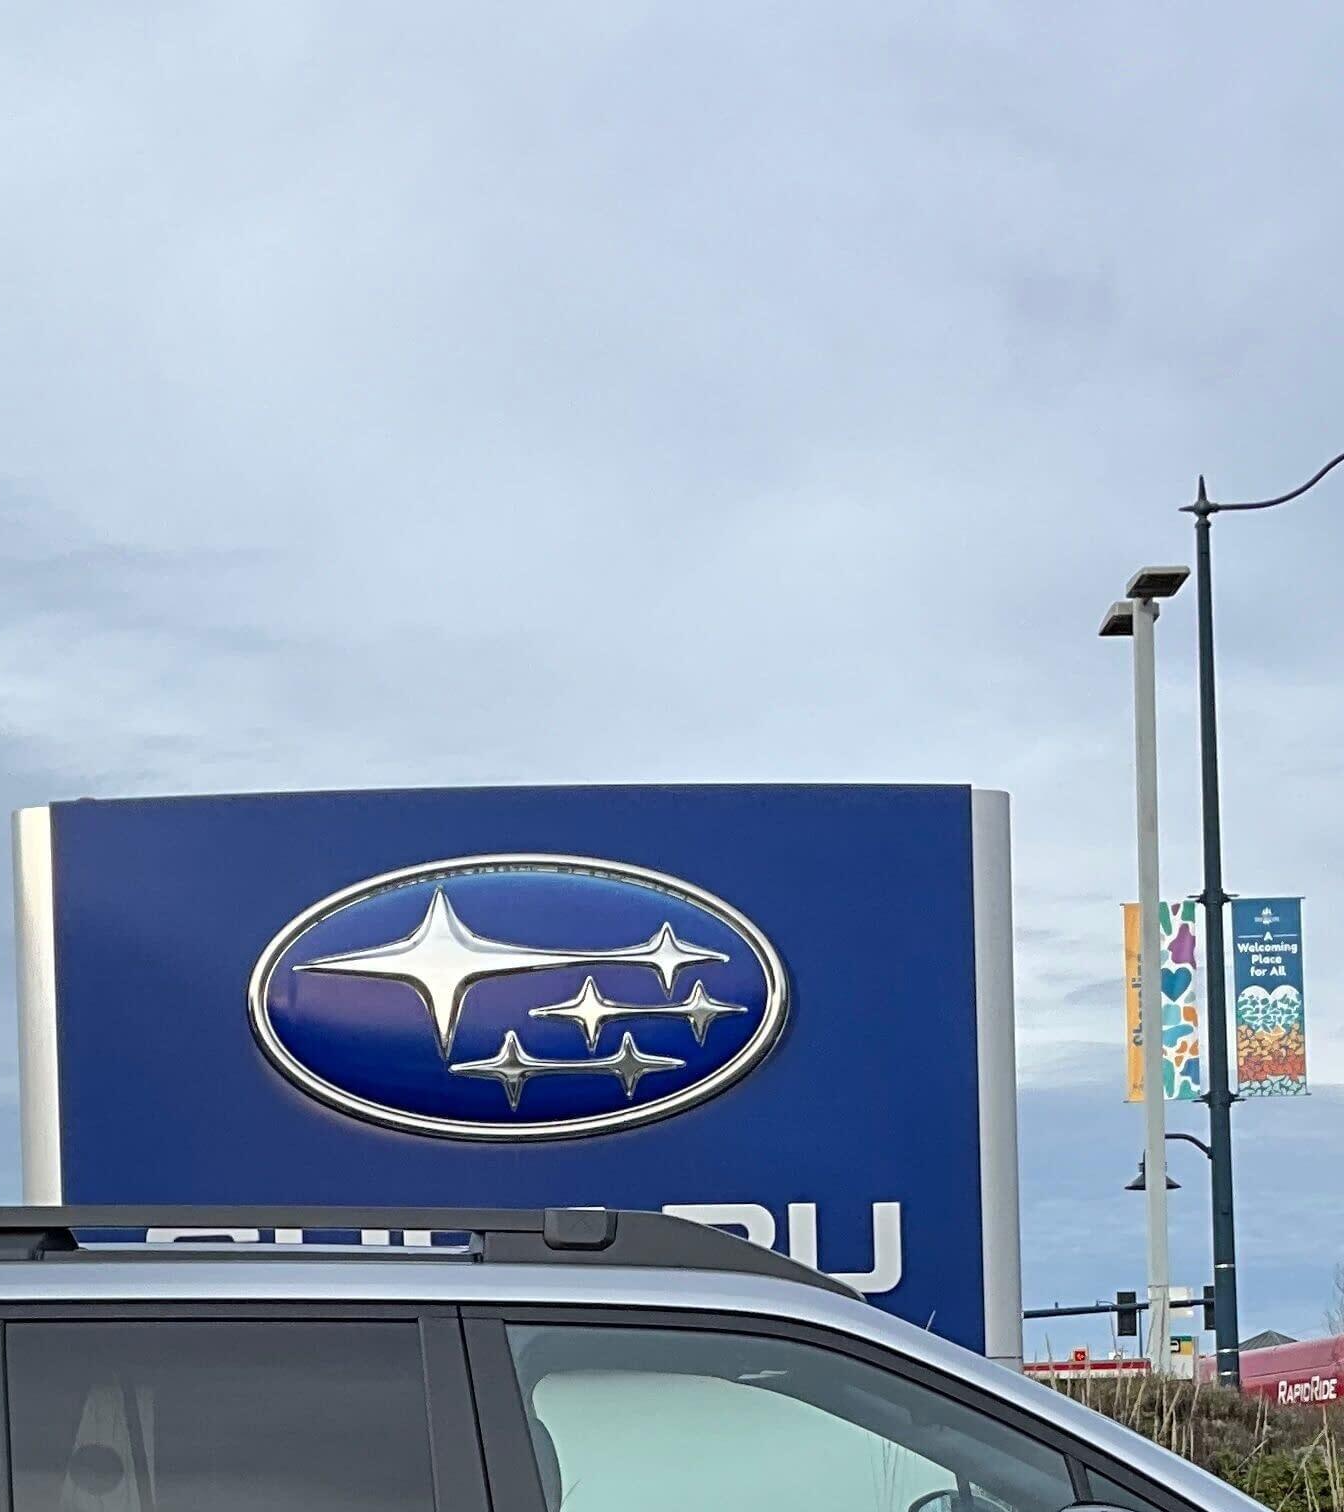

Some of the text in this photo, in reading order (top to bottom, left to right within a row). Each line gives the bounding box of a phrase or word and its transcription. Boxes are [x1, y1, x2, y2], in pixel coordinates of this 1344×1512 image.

[1263, 931, 1274, 941] A
[1237, 941, 1298, 954] Welcoming
[1251, 954, 1282, 965] Place
[1250, 965, 1287, 977] for All
